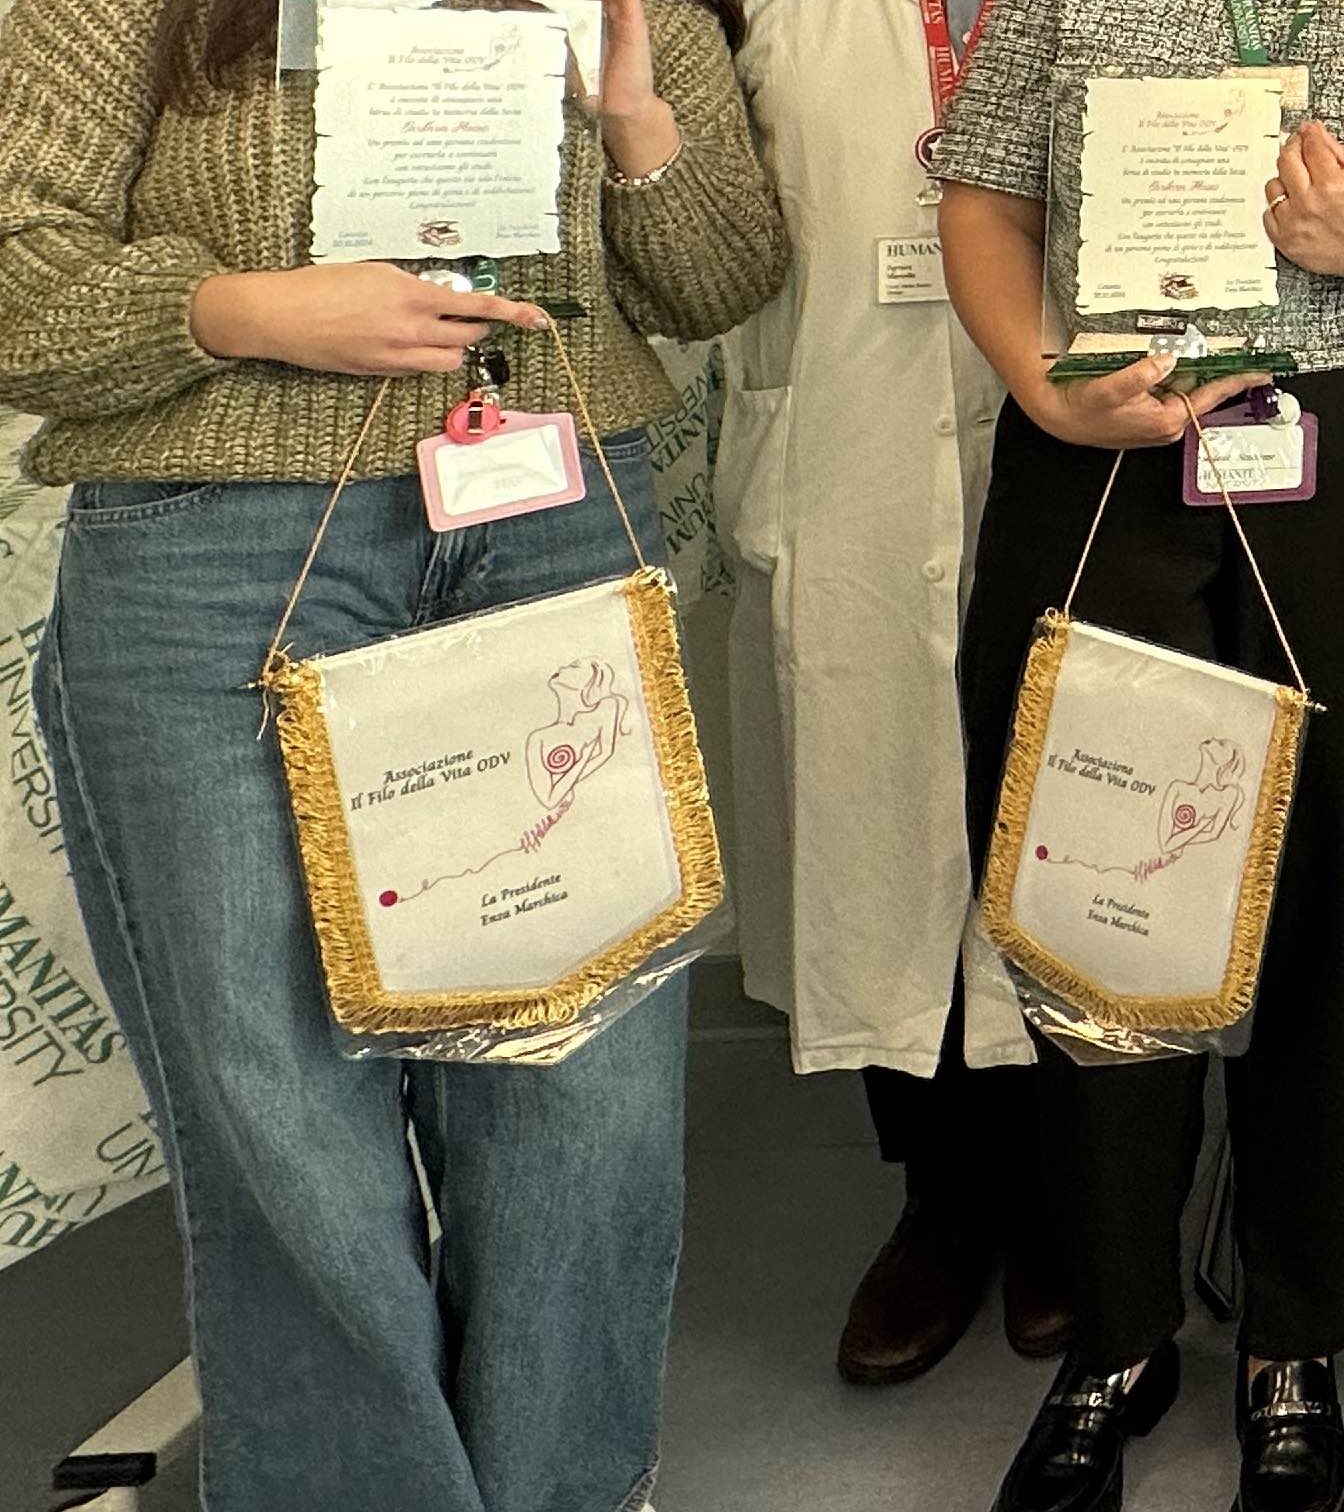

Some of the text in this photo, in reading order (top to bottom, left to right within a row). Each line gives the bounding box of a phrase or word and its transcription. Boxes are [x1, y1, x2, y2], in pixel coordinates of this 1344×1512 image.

[350, 751, 511, 812] Il Filo della Vita ODV
[382, 748, 474, 785] Associazione
[480, 872, 562, 909] La Presidente
